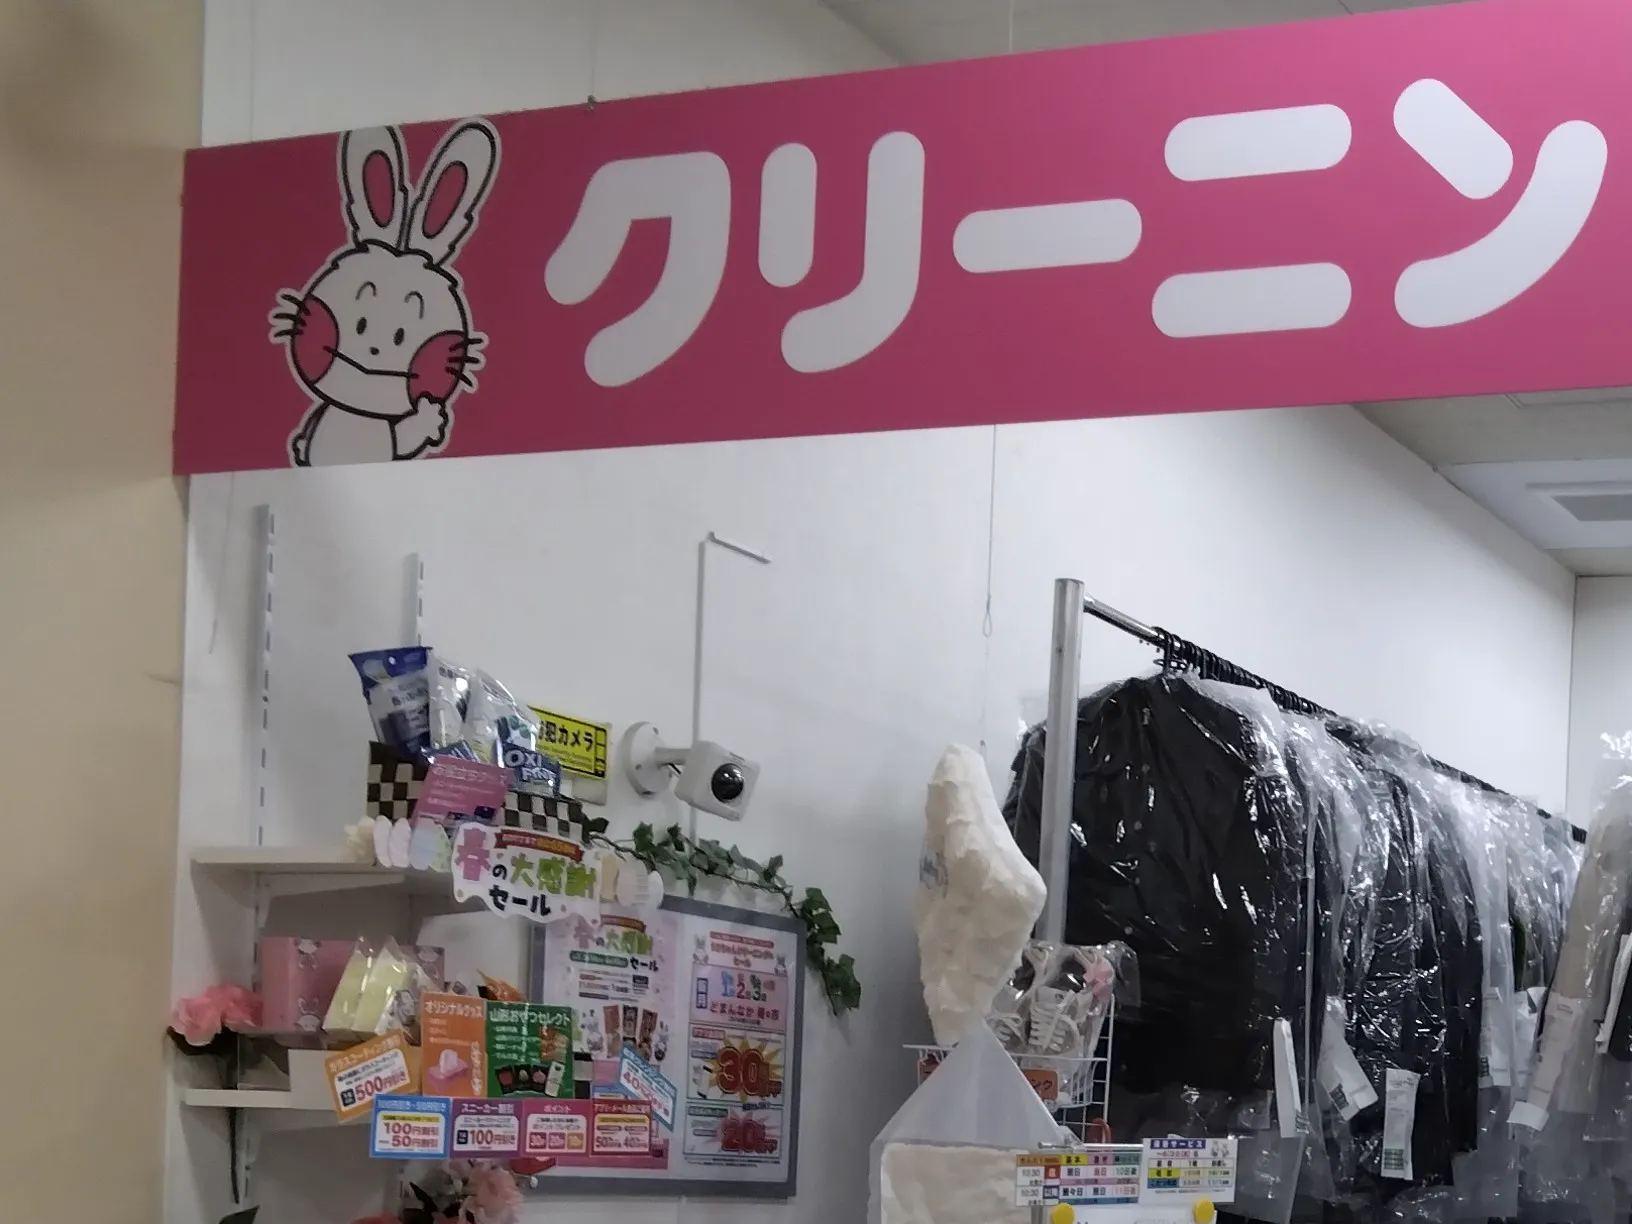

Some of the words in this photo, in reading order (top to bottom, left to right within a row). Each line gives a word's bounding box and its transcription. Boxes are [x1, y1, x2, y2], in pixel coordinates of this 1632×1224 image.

[505, 750, 541, 767] OXI
[455, 827, 596, 898] 春の大感謝
[489, 885, 551, 916] セール
